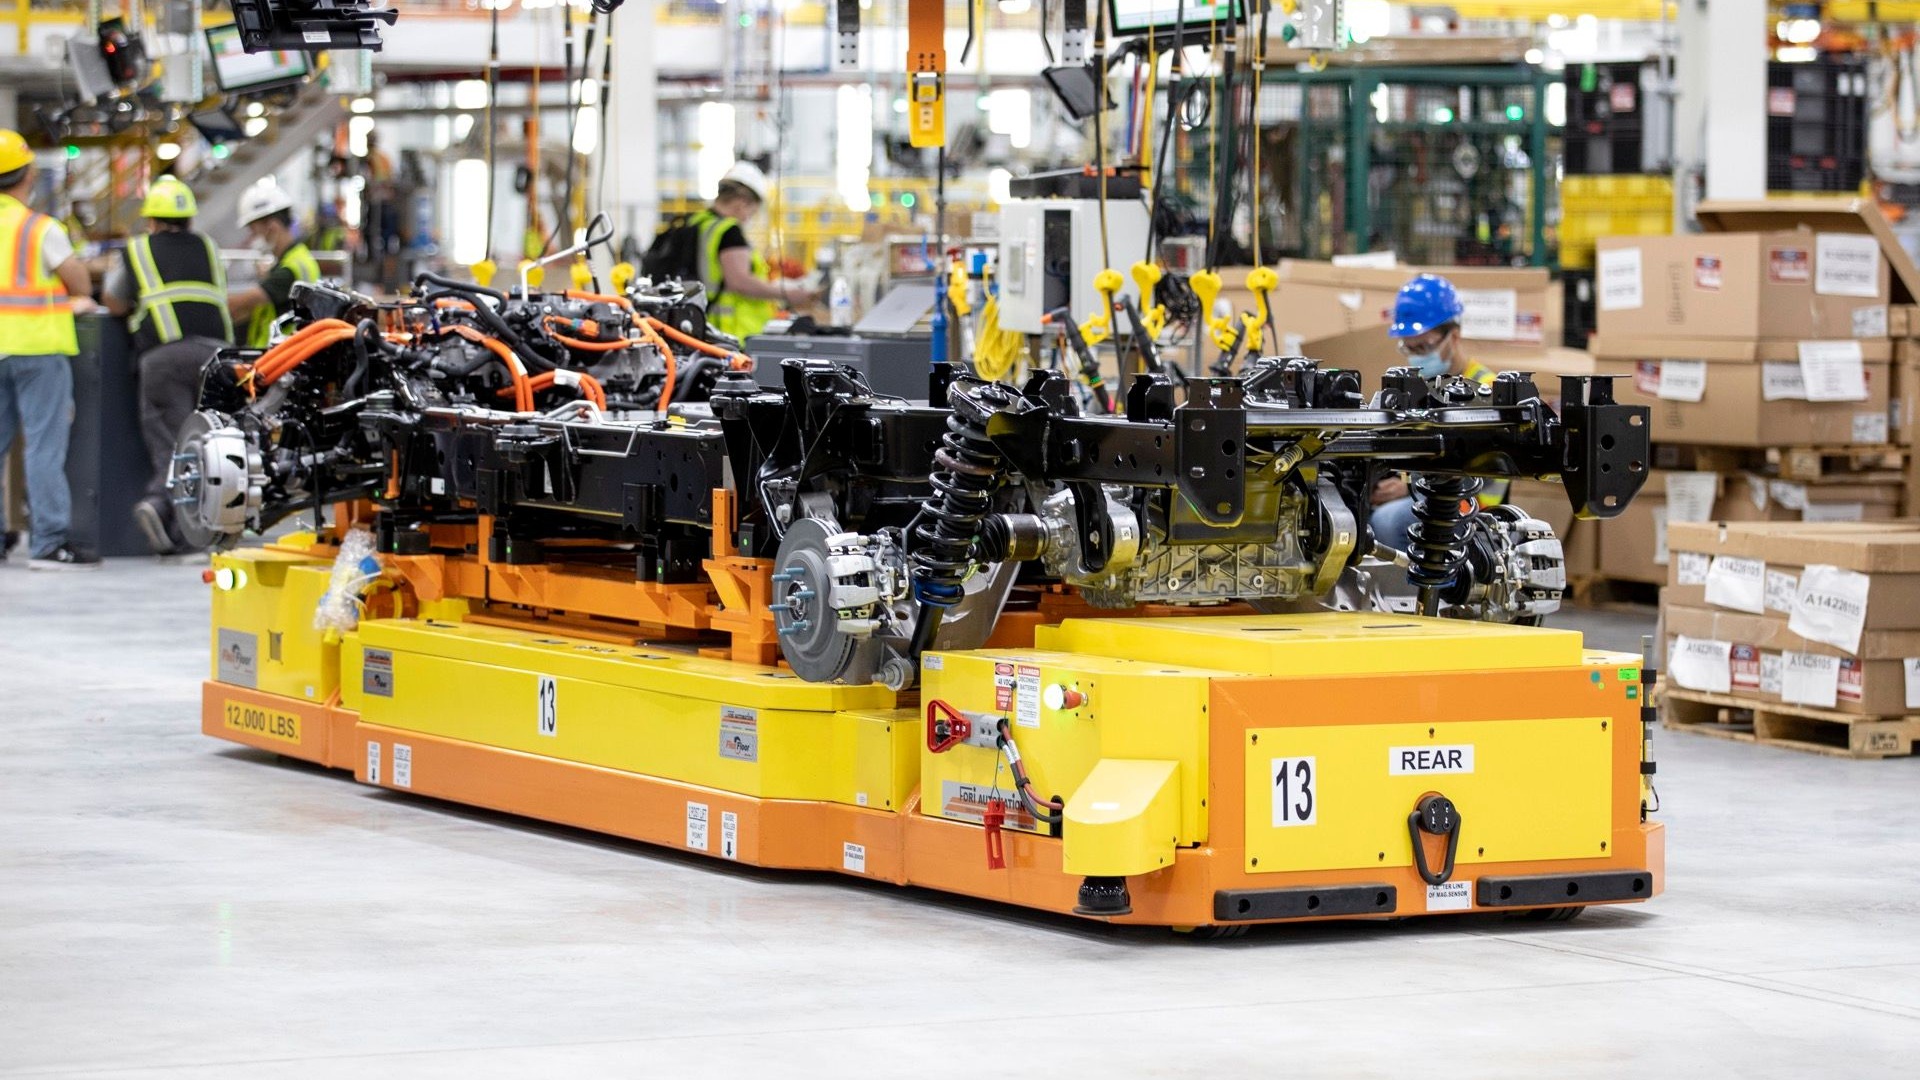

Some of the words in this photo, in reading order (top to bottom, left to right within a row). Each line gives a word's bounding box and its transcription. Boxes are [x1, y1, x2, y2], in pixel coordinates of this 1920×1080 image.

[227, 704, 266, 731] 12,000
[269, 713, 299, 739] LBS.
[540, 679, 555, 732] 13
[1402, 750, 1463, 770] REAR
[1276, 760, 1313, 821] 13
